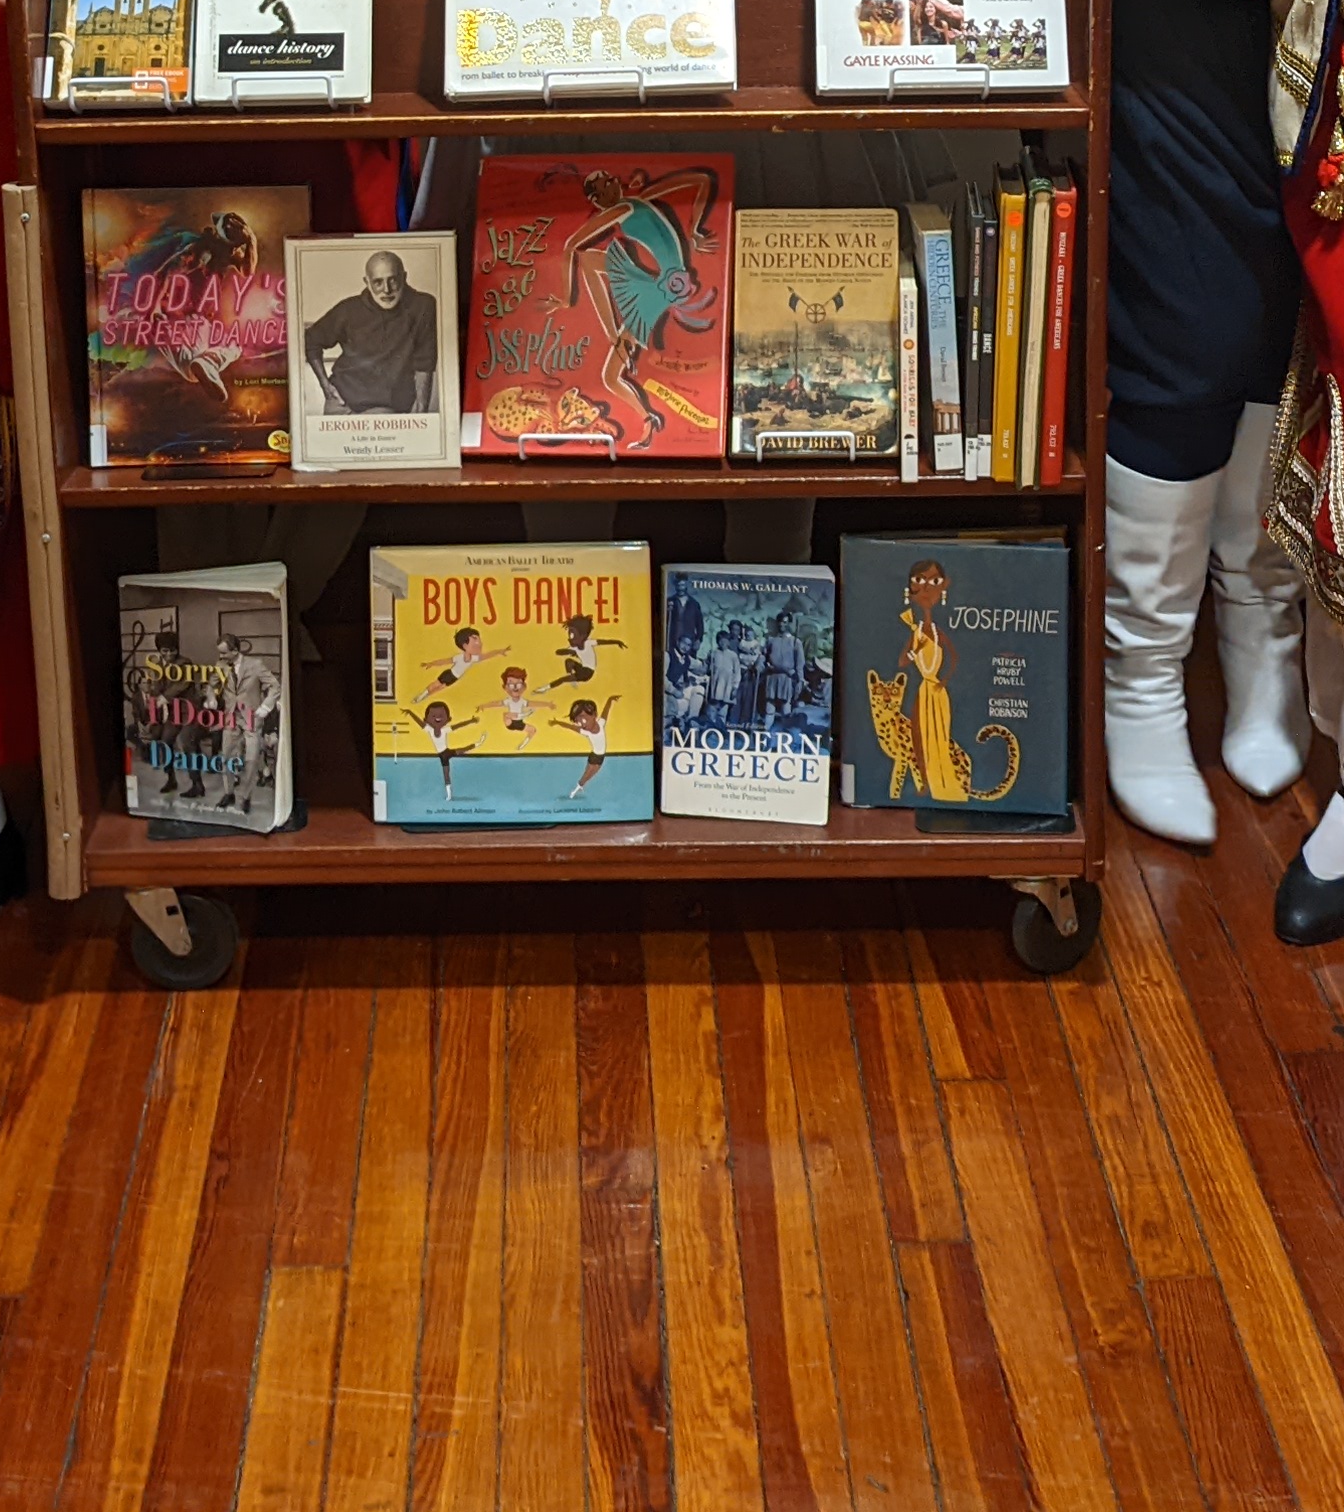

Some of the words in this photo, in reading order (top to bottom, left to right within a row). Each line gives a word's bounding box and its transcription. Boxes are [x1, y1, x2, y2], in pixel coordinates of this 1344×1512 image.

[456, 7, 717, 68] Dance
[227, 39, 275, 55] dance
[276, 39, 335, 59] history
[843, 55, 880, 67] GAYLE
[883, 54, 934, 66] KASSING
[461, 72, 480, 81] rom
[481, 70, 505, 80] ballet
[507, 71, 517, 79] to
[518, 69, 546, 79] breaki
[654, 64, 679, 73] world
[680, 63, 690, 72] of
[691, 62, 716, 72] dance
[481, 216, 555, 274] jazz
[741, 237, 761, 248] The
[765, 232, 831, 248] GREEK
[834, 232, 877, 248] WAR
[882, 237, 894, 250] of
[740, 253, 893, 269] INDEPENDENCE
[927, 240, 937, 277] HIDDEN
[936, 238, 952, 308] GREECE,
[1057, 265, 1065, 283] GREEK
[483, 268, 536, 319] age
[929, 278, 938, 329] CENTURIES
[1056, 284, 1064, 306] DANCES
[939, 310, 947, 327] THE
[1055, 306, 1063, 317] FOR
[103, 320, 205, 345] STREET
[1054, 319, 1062, 349] AMERICANS
[476, 317, 591, 379] josephine
[982, 333, 992, 354] DANCE
[908, 394, 916, 408] FOR
[319, 420, 370, 432] JEROME
[373, 418, 428, 430] ROBBINS
[343, 446, 372, 456] Wendy
[374, 445, 404, 454] Lesser
[465, 556, 506, 566] AMERICAN
[508, 556, 538, 565] BALLET
[692, 580, 739, 591] THOMAS
[740, 582, 754, 592] W.
[755, 583, 808, 594] GALLANT
[423, 577, 497, 625] BOYS
[513, 576, 620, 625] DANCE!
[949, 607, 1059, 634] JOSEPHINE
[992, 657, 1026, 668] PATRICIA
[145, 653, 232, 696] Sorry
[993, 676, 1025, 686] POWELL
[988, 698, 1029, 708] CHRISTIAN
[989, 707, 1028, 718] ROBINSON
[147, 696, 158, 725] I
[172, 698, 256, 732] Don't
[670, 727, 822, 756] MODERN
[150, 740, 244, 775] Dance
[671, 751, 820, 783] GREECE
[693, 781, 712, 789] From
[714, 782, 724, 790] the
[749, 785, 795, 795] Independence
